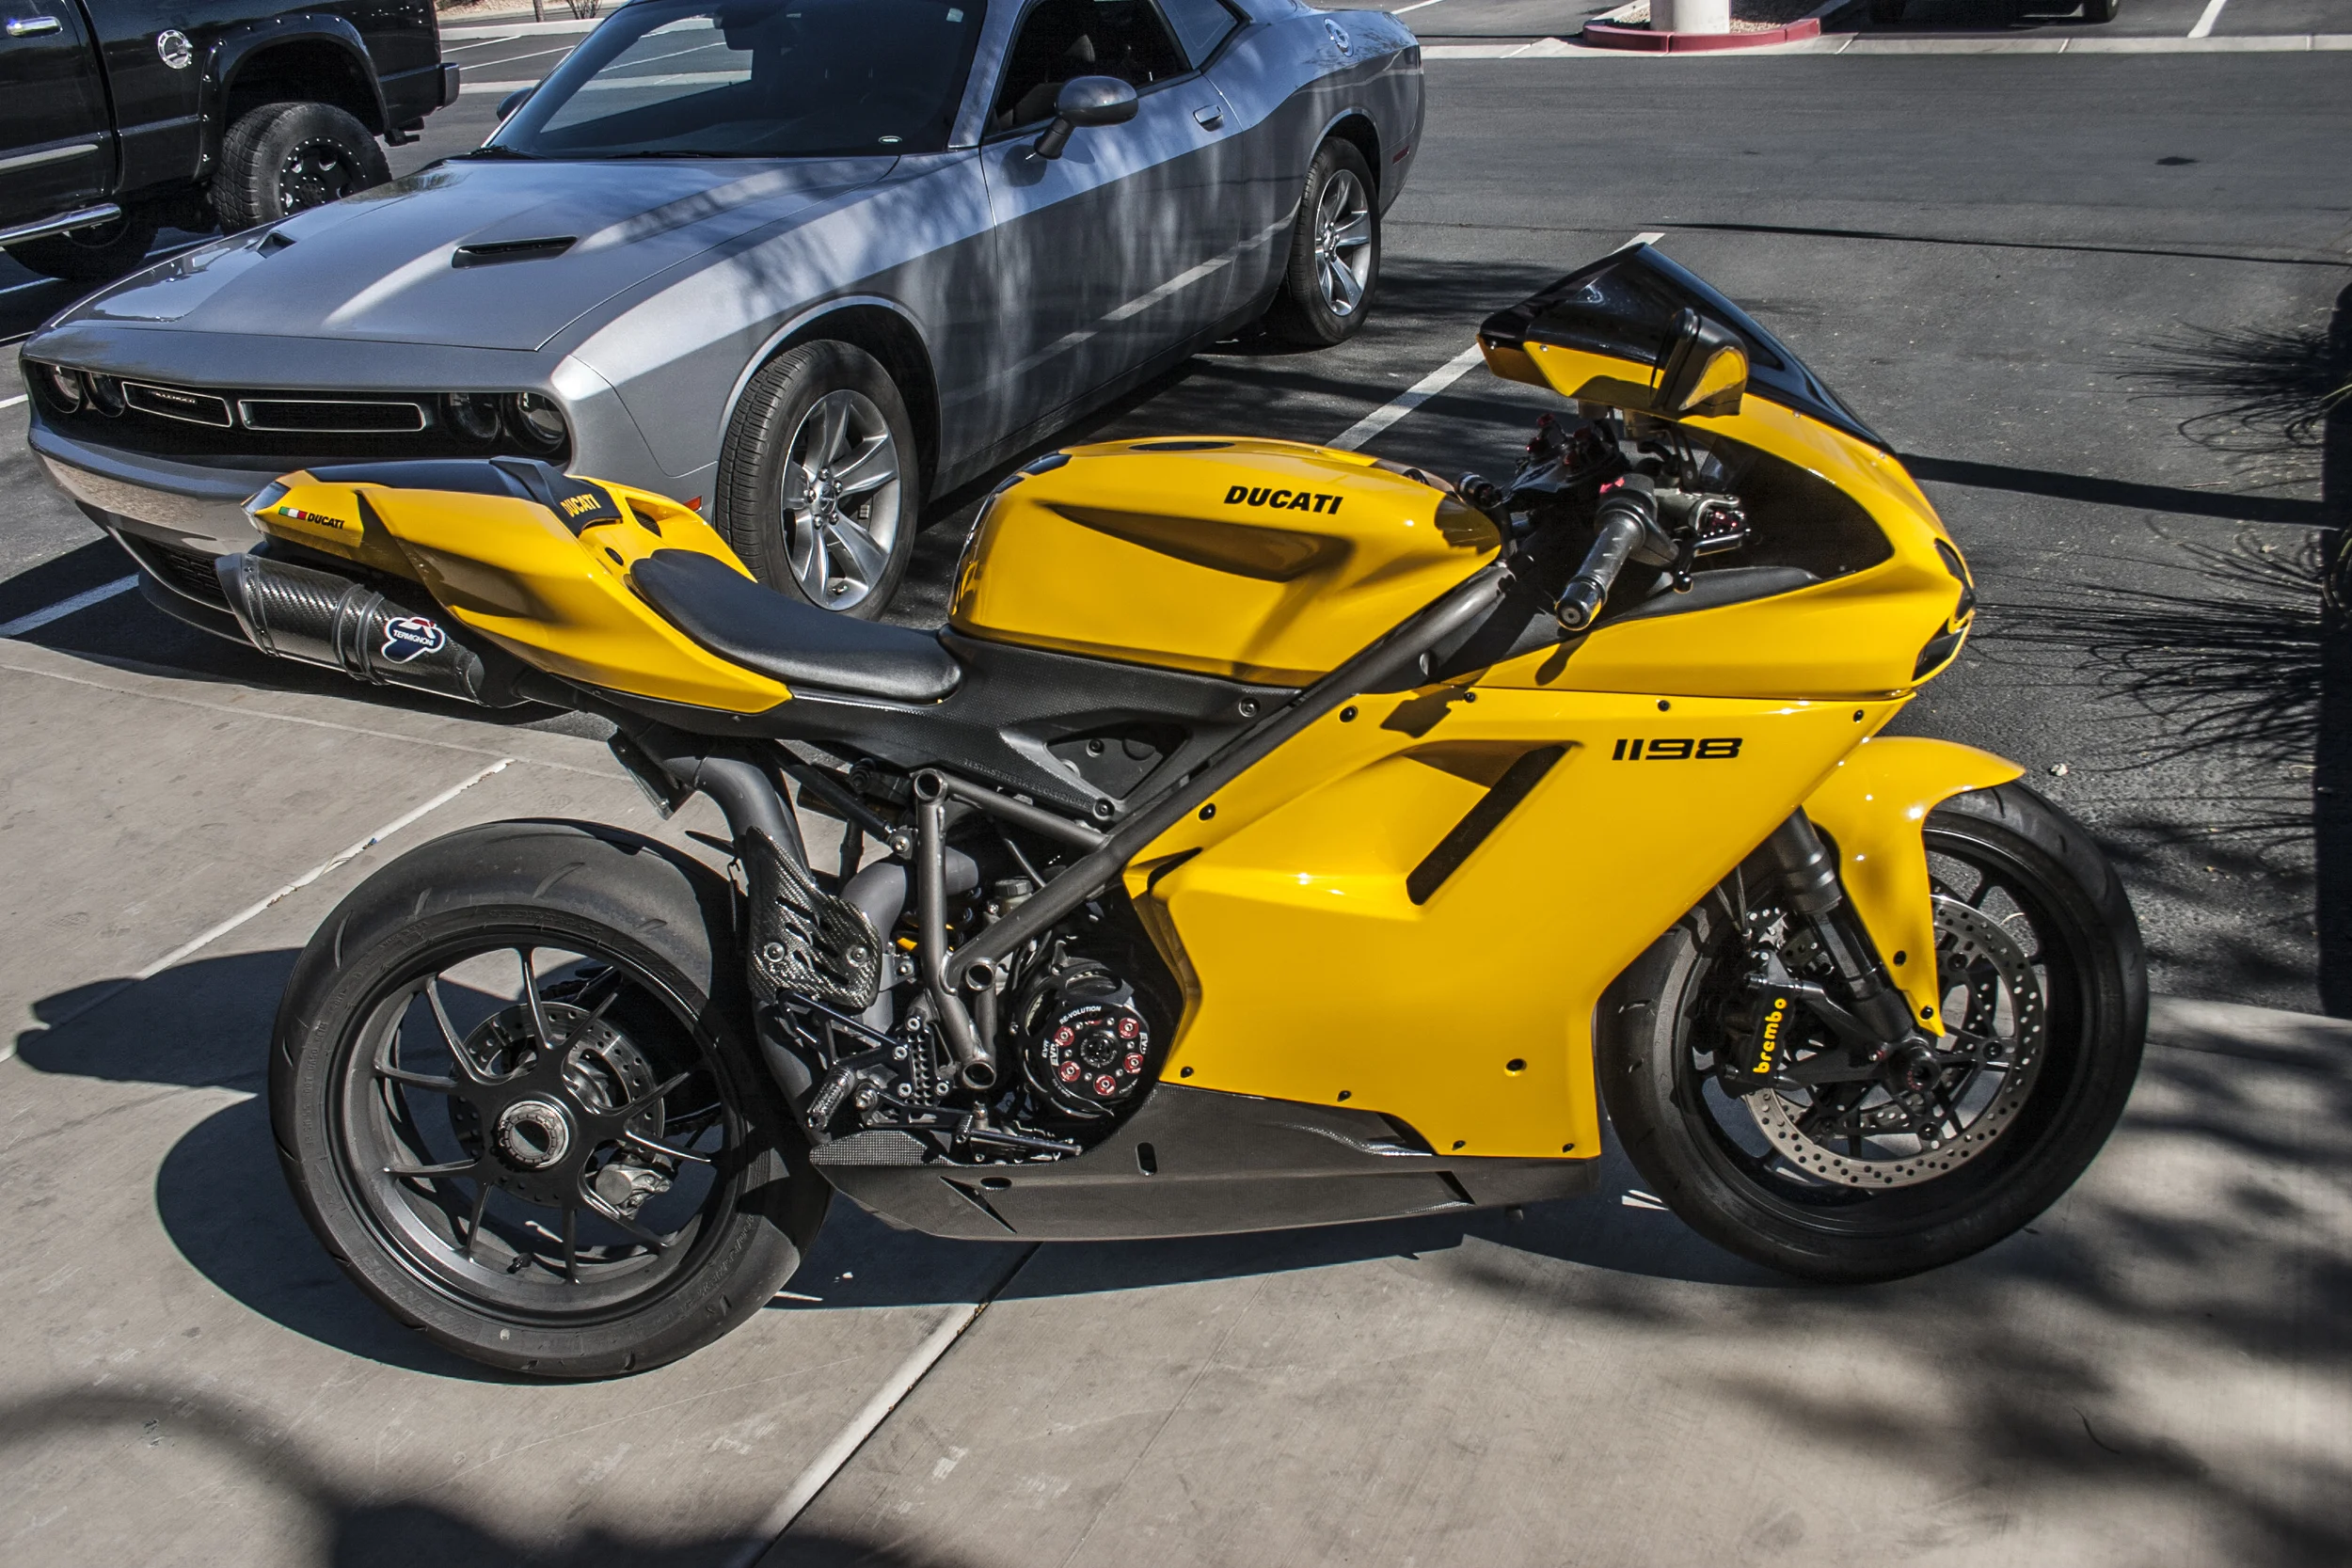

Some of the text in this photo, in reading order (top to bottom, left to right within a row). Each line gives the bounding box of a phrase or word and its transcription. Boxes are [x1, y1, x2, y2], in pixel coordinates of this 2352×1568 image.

[559, 493, 602, 518] DUCATI
[1223, 484, 1344, 515] DUCATI
[307, 512, 345, 530] DUCATI
[1611, 737, 1743, 761] 1198
[1058, 1005, 1102, 1025] RE-VOLUTION
[1752, 997, 1788, 1074] brembo
